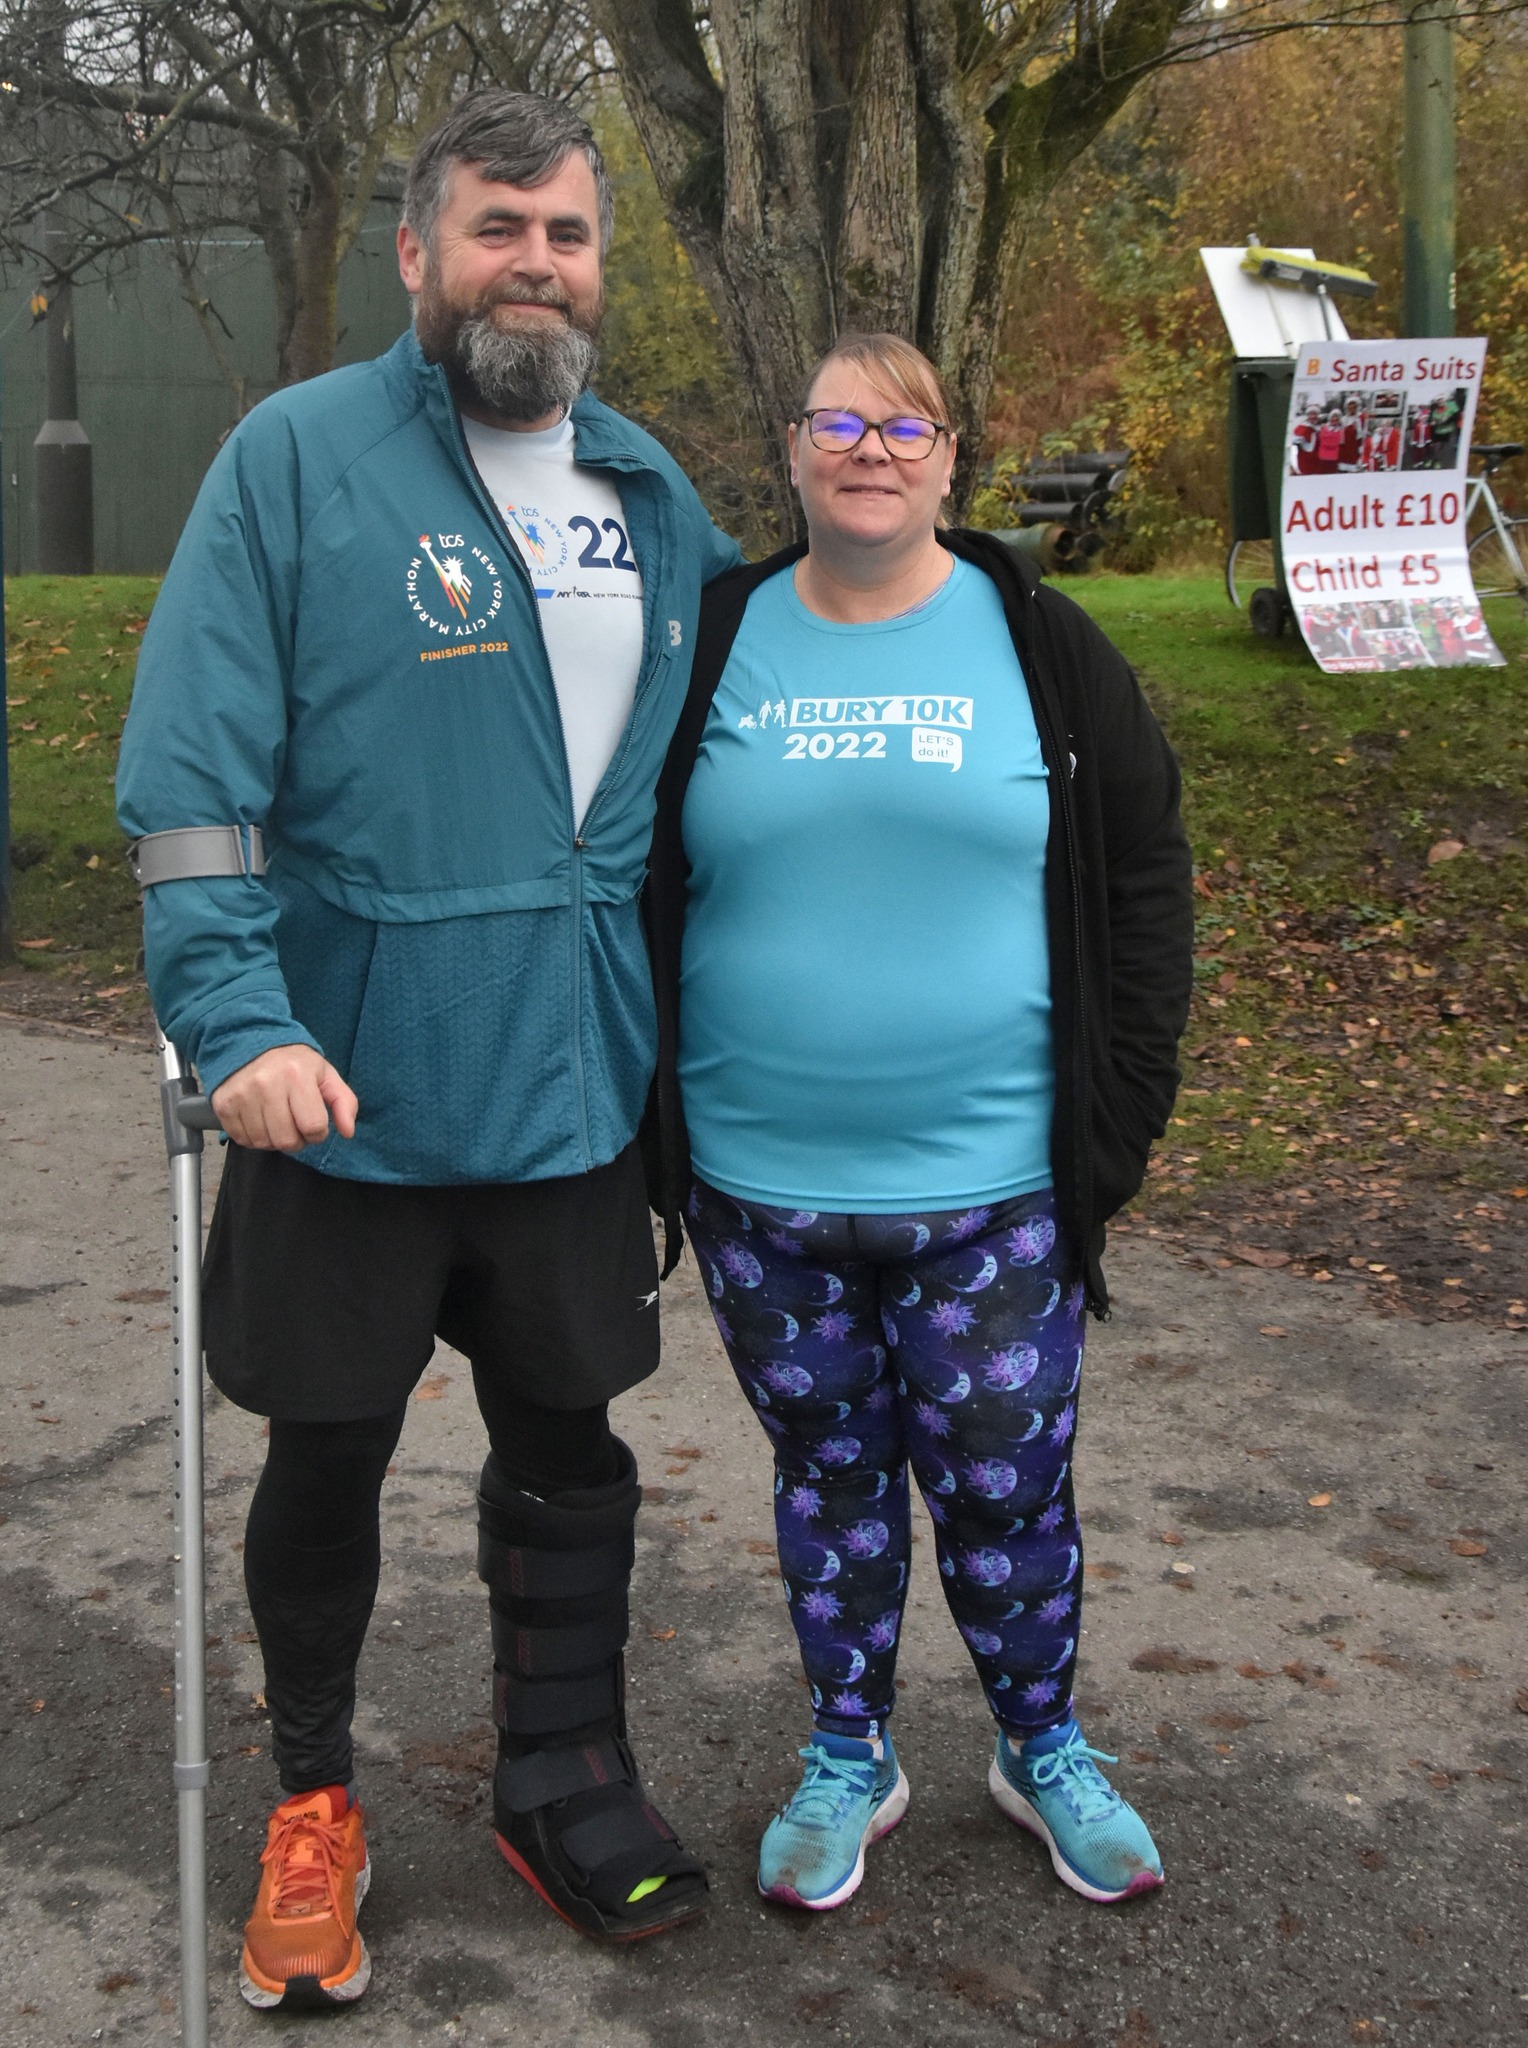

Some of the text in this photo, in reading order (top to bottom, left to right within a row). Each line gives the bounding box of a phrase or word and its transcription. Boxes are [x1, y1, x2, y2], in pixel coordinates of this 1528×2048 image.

[1331, 357, 1477, 383] Santa Suits
[1286, 492, 1459, 533] Adult £10
[438, 533, 465, 549] tcs
[537, 518, 568, 576] NEW YORK CITY
[567, 515, 638, 573] 22
[1291, 553, 1441, 594] Child £5
[406, 547, 503, 636] NEW YORK CITY MARATHON
[420, 642, 509, 662] FINISHER 2022
[796, 698, 969, 726] BURY 10K
[782, 731, 887, 760] 2022
[918, 734, 954, 747] LET'S
[918, 747, 949, 758] do it!
